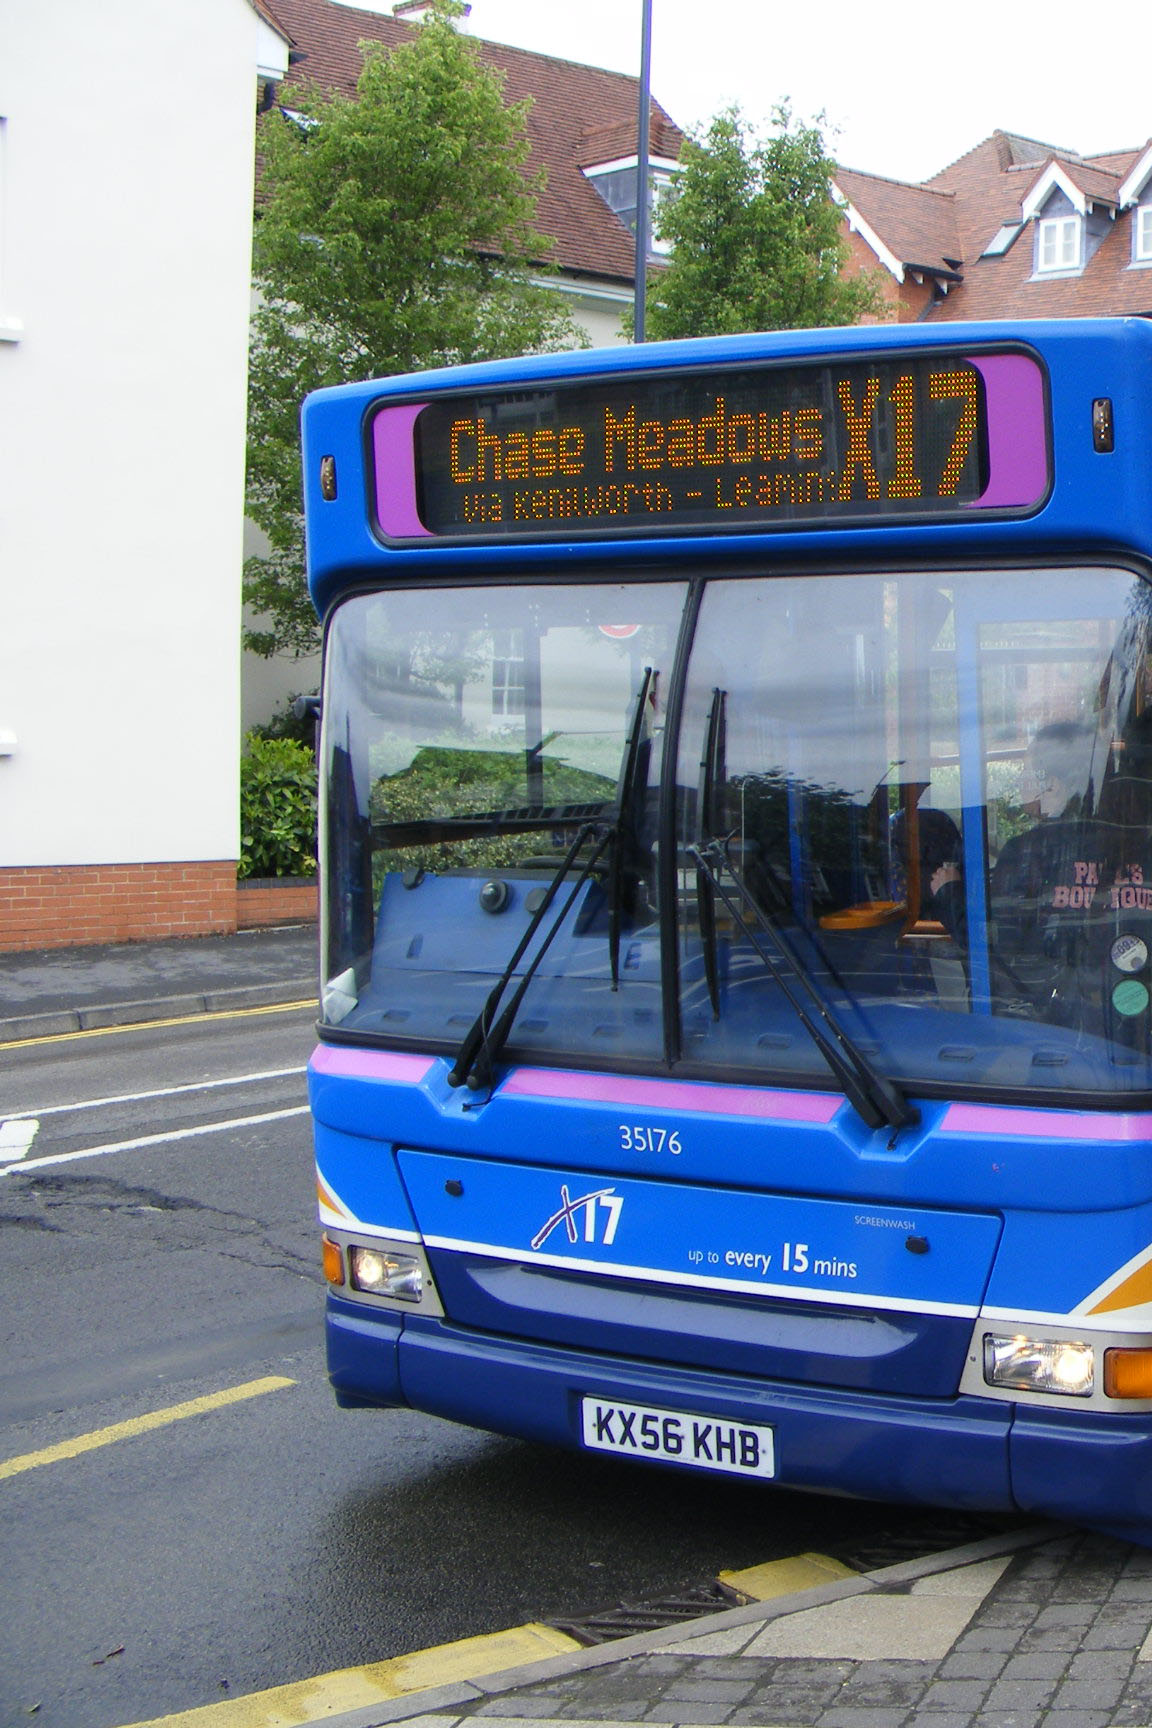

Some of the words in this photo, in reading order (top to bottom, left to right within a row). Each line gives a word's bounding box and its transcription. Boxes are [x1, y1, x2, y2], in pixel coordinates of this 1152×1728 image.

[451, 418, 585, 483] Chase
[605, 398, 824, 473] Meadows
[838, 371, 978, 500] X17
[1074, 861, 1144, 886] PAL'S
[619, 1125, 682, 1155] 35176
[531, 1184, 624, 1250] X17
[854, 1215, 916, 1230] SCREENWASH
[688, 1250, 704, 1264] up
[707, 1250, 719, 1264] to
[725, 1249, 771, 1275] every
[782, 1242, 809, 1273] 15
[813, 1257, 858, 1279] mins
[596, 1406, 683, 1455] KX56
[693, 1422, 760, 1468] KHB
